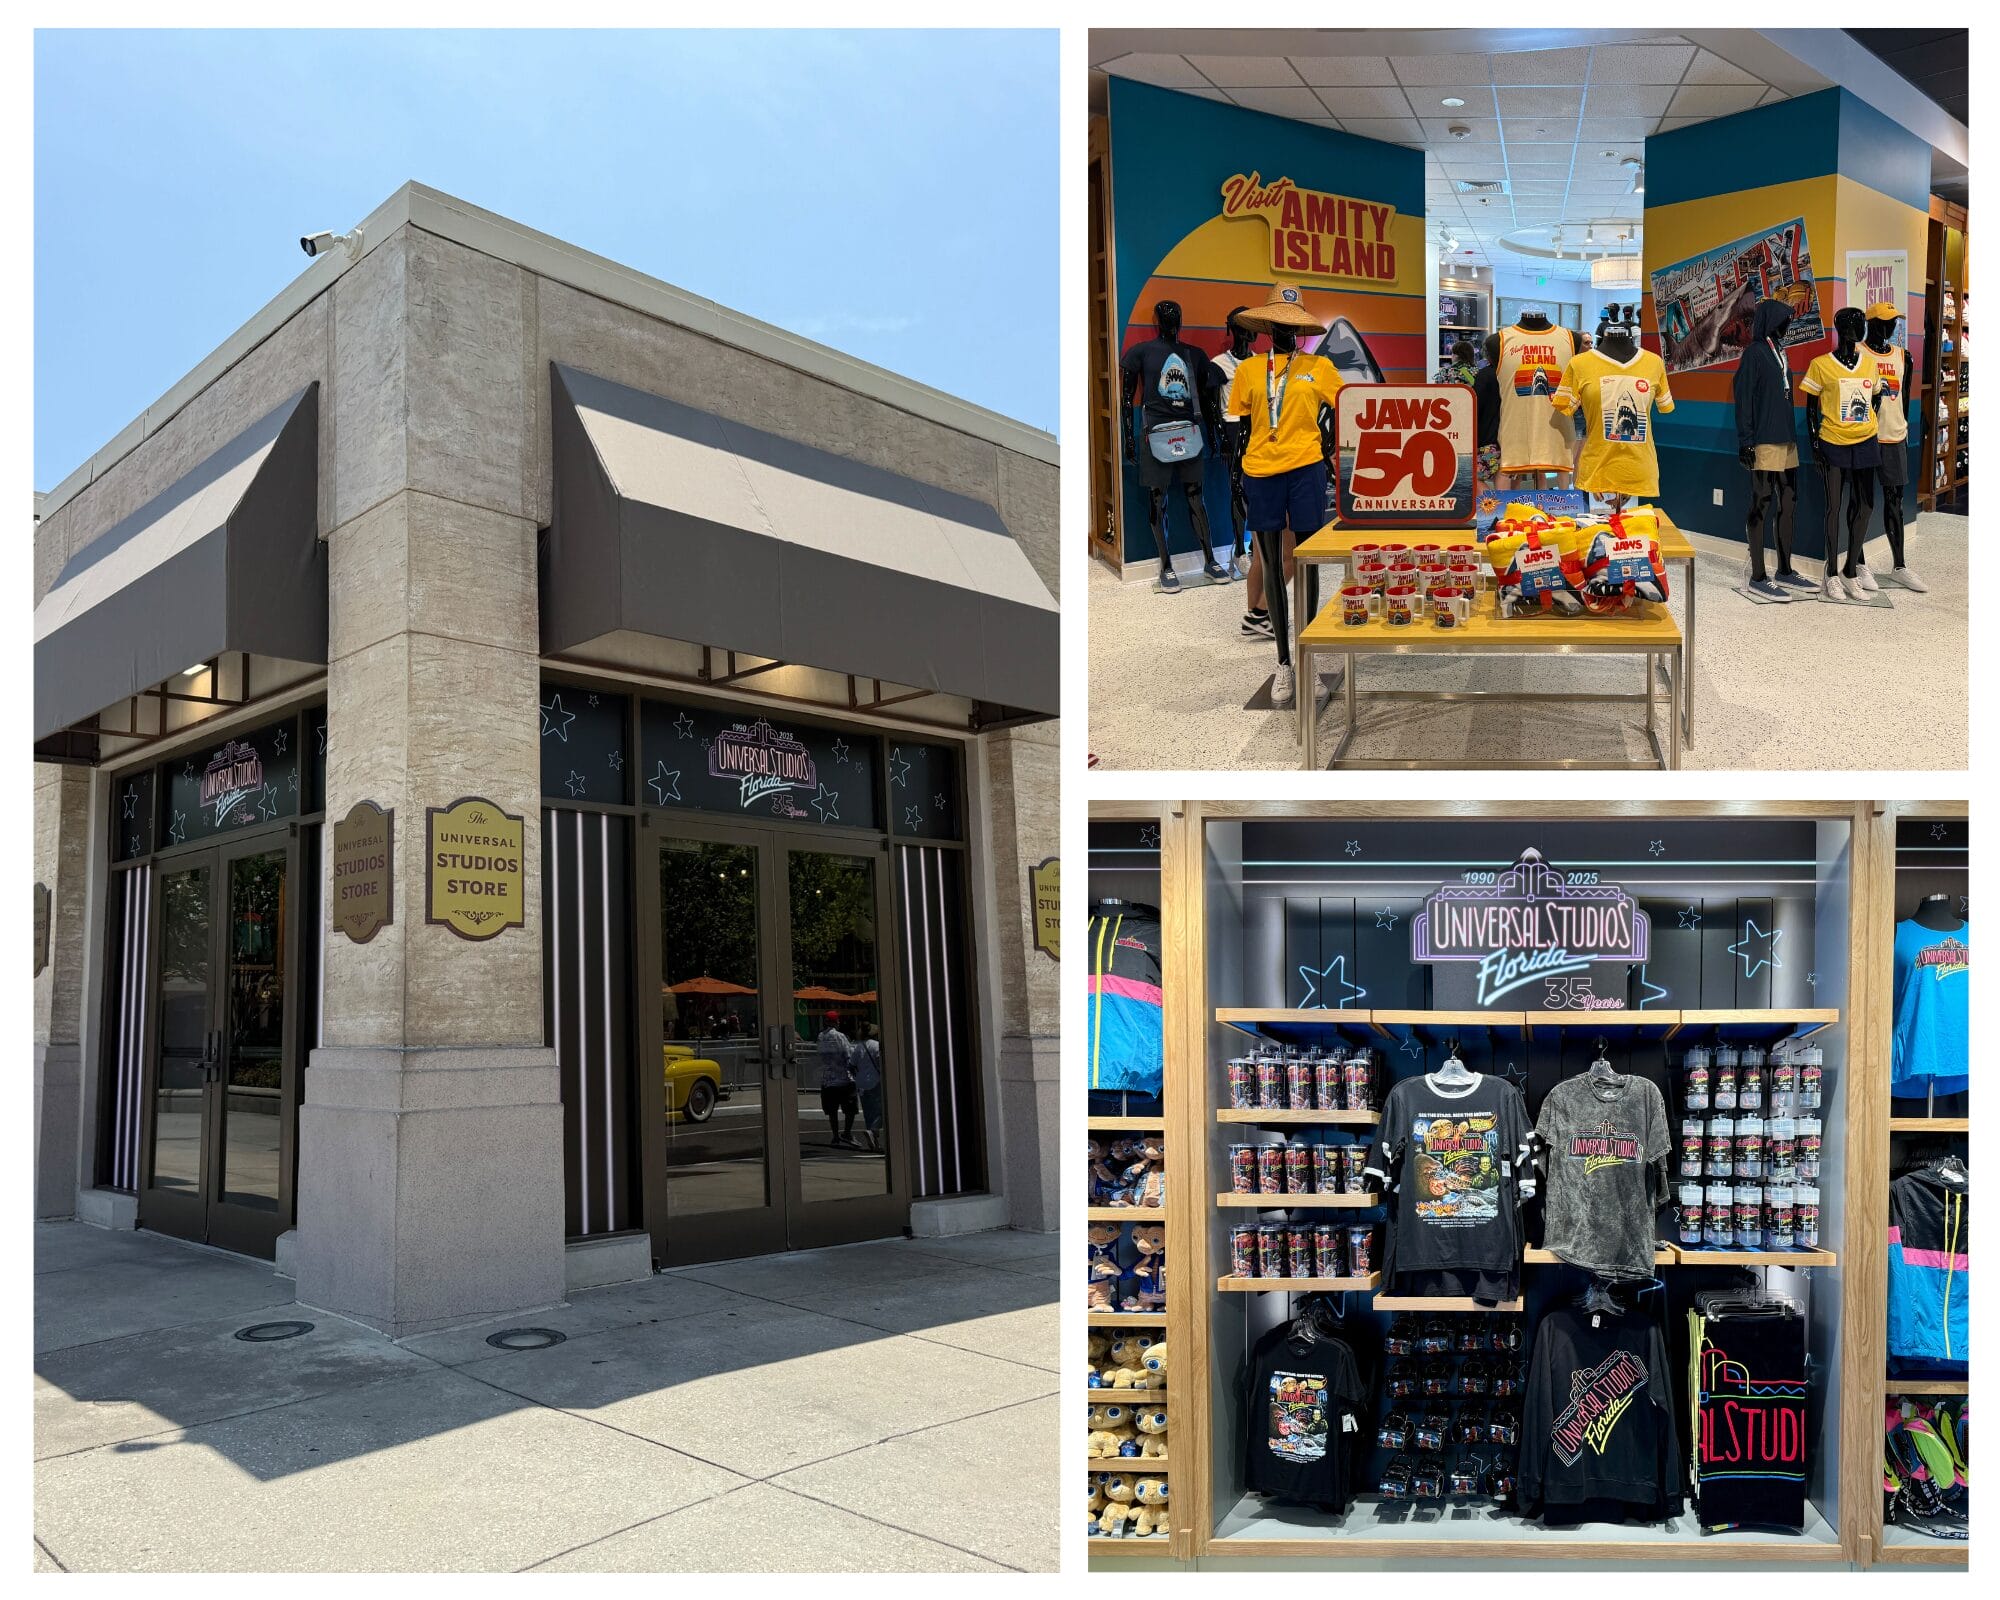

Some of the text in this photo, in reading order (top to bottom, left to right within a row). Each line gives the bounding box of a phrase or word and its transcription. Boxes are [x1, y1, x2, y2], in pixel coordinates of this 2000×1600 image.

[1226, 175, 1389, 242] Visit AMITY
[1274, 228, 1395, 280] ISLAND
[1655, 256, 1709, 300] Greetings
[1711, 247, 1737, 271] FROM
[1867, 266, 1893, 289] AMITY
[1522, 355, 1556, 365] ISLAND
[1523, 345, 1554, 355] AMITY
[1355, 398, 1452, 430] JAWS
[1351, 431, 1459, 497] 50 TH
[1354, 499, 1456, 509] ANNIVERSARY
[1612, 540, 1643, 552] JAWS
[1523, 550, 1553, 564] JAWS
[732, 723, 794, 741] 1990 2025
[718, 740, 809, 781] UNIVERSAL STUDIOS
[739, 773, 795, 808] Florida
[770, 793, 793, 816] 35
[467, 810, 488, 825] The
[337, 835, 384, 853] UNIVERSAL
[440, 832, 516, 848] UNIVERSAL
[335, 854, 385, 877] STUDIOS
[437, 852, 518, 873] STUDIOS
[447, 879, 508, 896] STORE
[1463, 871, 1599, 885] 1990 2025
[341, 881, 378, 900] STORE
[1476, 942, 1599, 1006] Florida
[1543, 977, 1625, 1012] 35 Years
[1585, 1154, 1626, 1175] Florida
[1585, 1391, 1634, 1456] Florida
